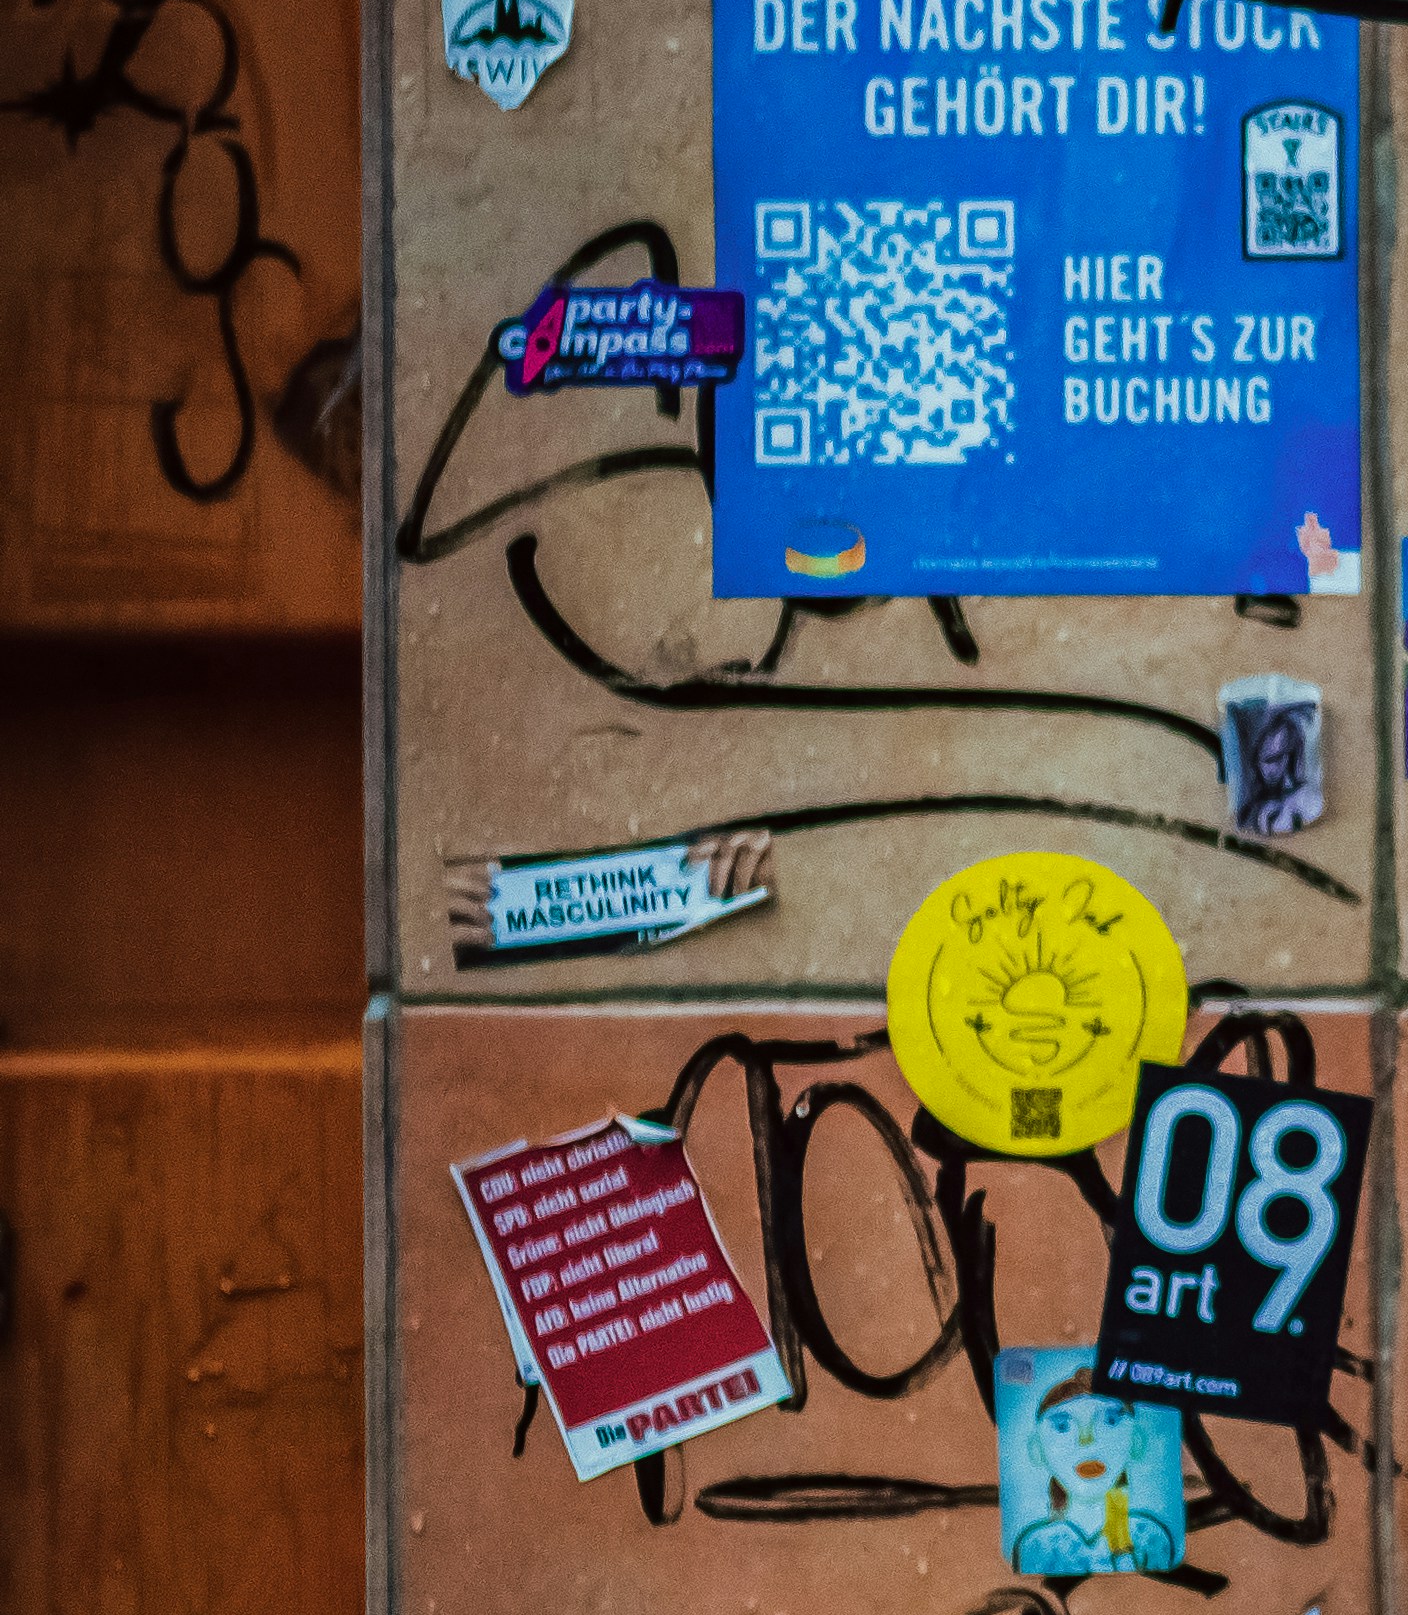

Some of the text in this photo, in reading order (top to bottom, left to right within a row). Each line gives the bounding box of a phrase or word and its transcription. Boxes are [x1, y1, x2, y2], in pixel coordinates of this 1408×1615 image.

[864, 64, 1206, 137] GEHÖRT DIR!
[1063, 253, 1165, 301] HIER
[1233, 314, 1319, 363] ZUR
[1063, 376, 1272, 425] BUCHUNG
[504, 885, 692, 932] MASCULINITY
[534, 865, 658, 903] RETHINK
[520, 1154, 566, 1187] nicht
[533, 1185, 577, 1220] nicht
[579, 1165, 630, 1204] sozial
[563, 1212, 608, 1247] nicht
[608, 1178, 696, 1231] ökologisch
[559, 1252, 603, 1287] nicht
[602, 1227, 660, 1269] liberal
[568, 1288, 618, 1323] keine
[617, 1250, 710, 1303] Alternative
[639, 1297, 684, 1333] nicht
[683, 1276, 735, 1316] lustig
[1125, 1264, 1220, 1325] art
[595, 1367, 761, 1450] Die PARTEI
